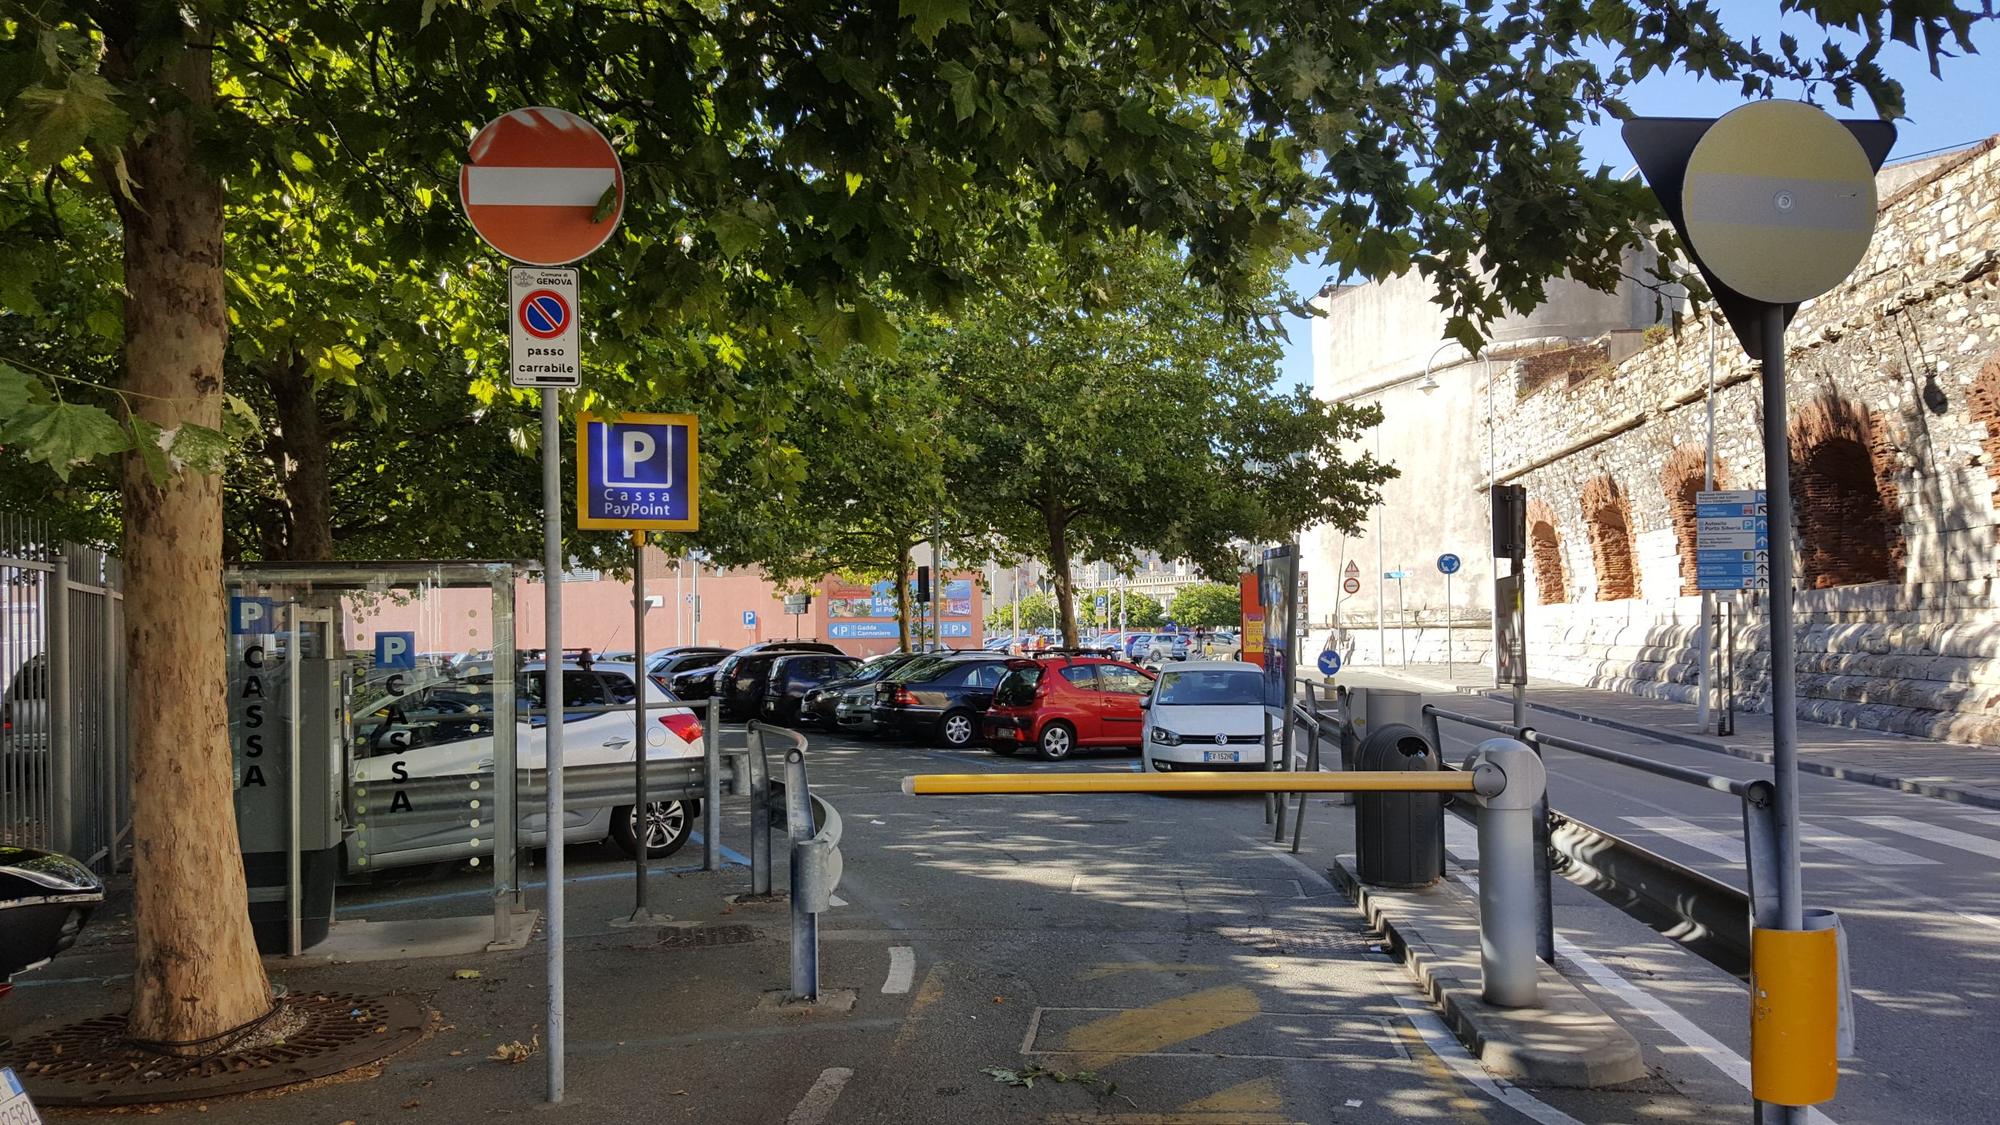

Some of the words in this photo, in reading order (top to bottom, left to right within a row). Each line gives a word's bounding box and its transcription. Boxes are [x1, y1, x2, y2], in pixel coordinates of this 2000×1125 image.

[528, 348, 564, 357] passo
[519, 364, 574, 373] carrabile
[623, 431, 656, 478] P
[604, 489, 670, 502] Cassa
[604, 502, 670, 517] PayPoint
[240, 602, 263, 629] P
[745, 612, 753, 624] P
[383, 636, 406, 663] P
[242, 646, 267, 787] CASSA
[385, 674, 413, 813] CASSA
